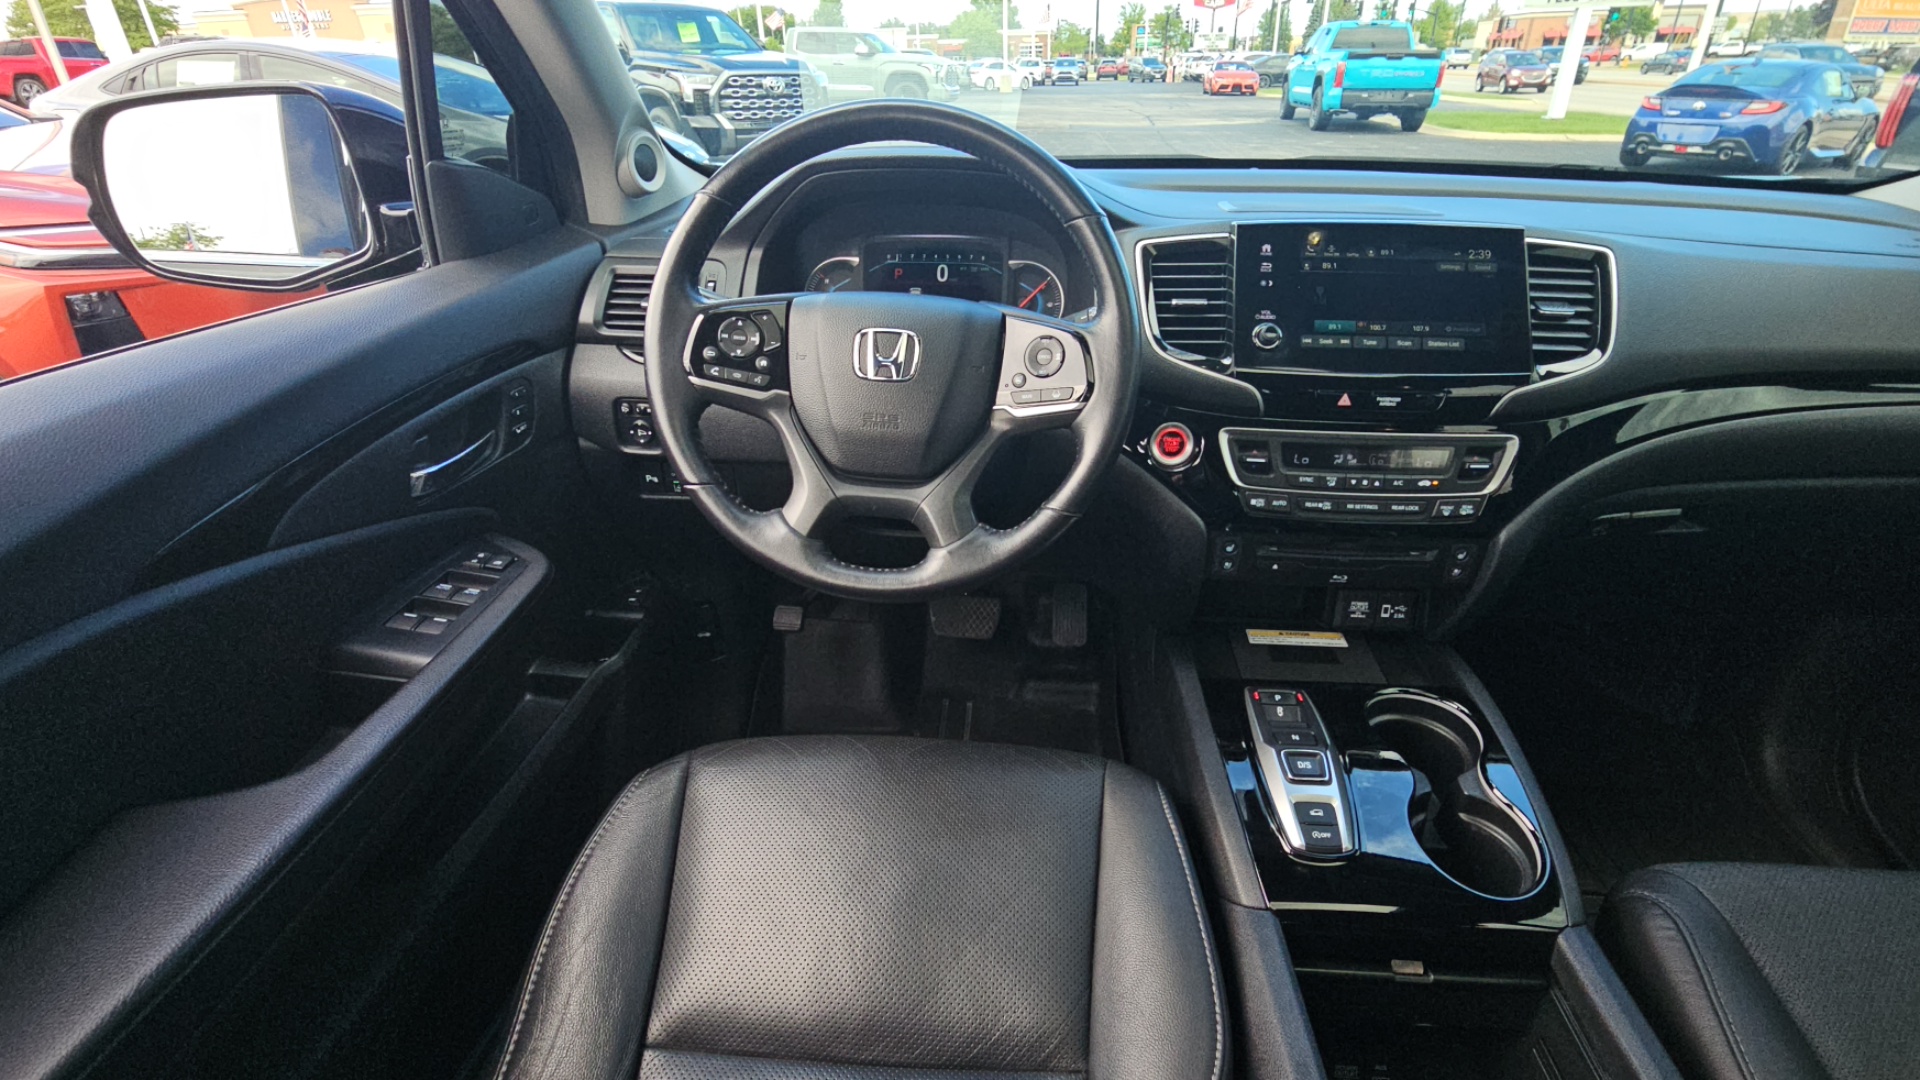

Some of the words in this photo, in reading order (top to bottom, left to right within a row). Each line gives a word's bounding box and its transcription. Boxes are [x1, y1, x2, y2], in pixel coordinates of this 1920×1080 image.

[1468, 249, 1492, 259] 2:39
[894, 268, 904, 280] P
[936, 264, 949, 282] 0
[1427, 340, 1448, 348] Station
[1297, 760, 1312, 769] D/S
